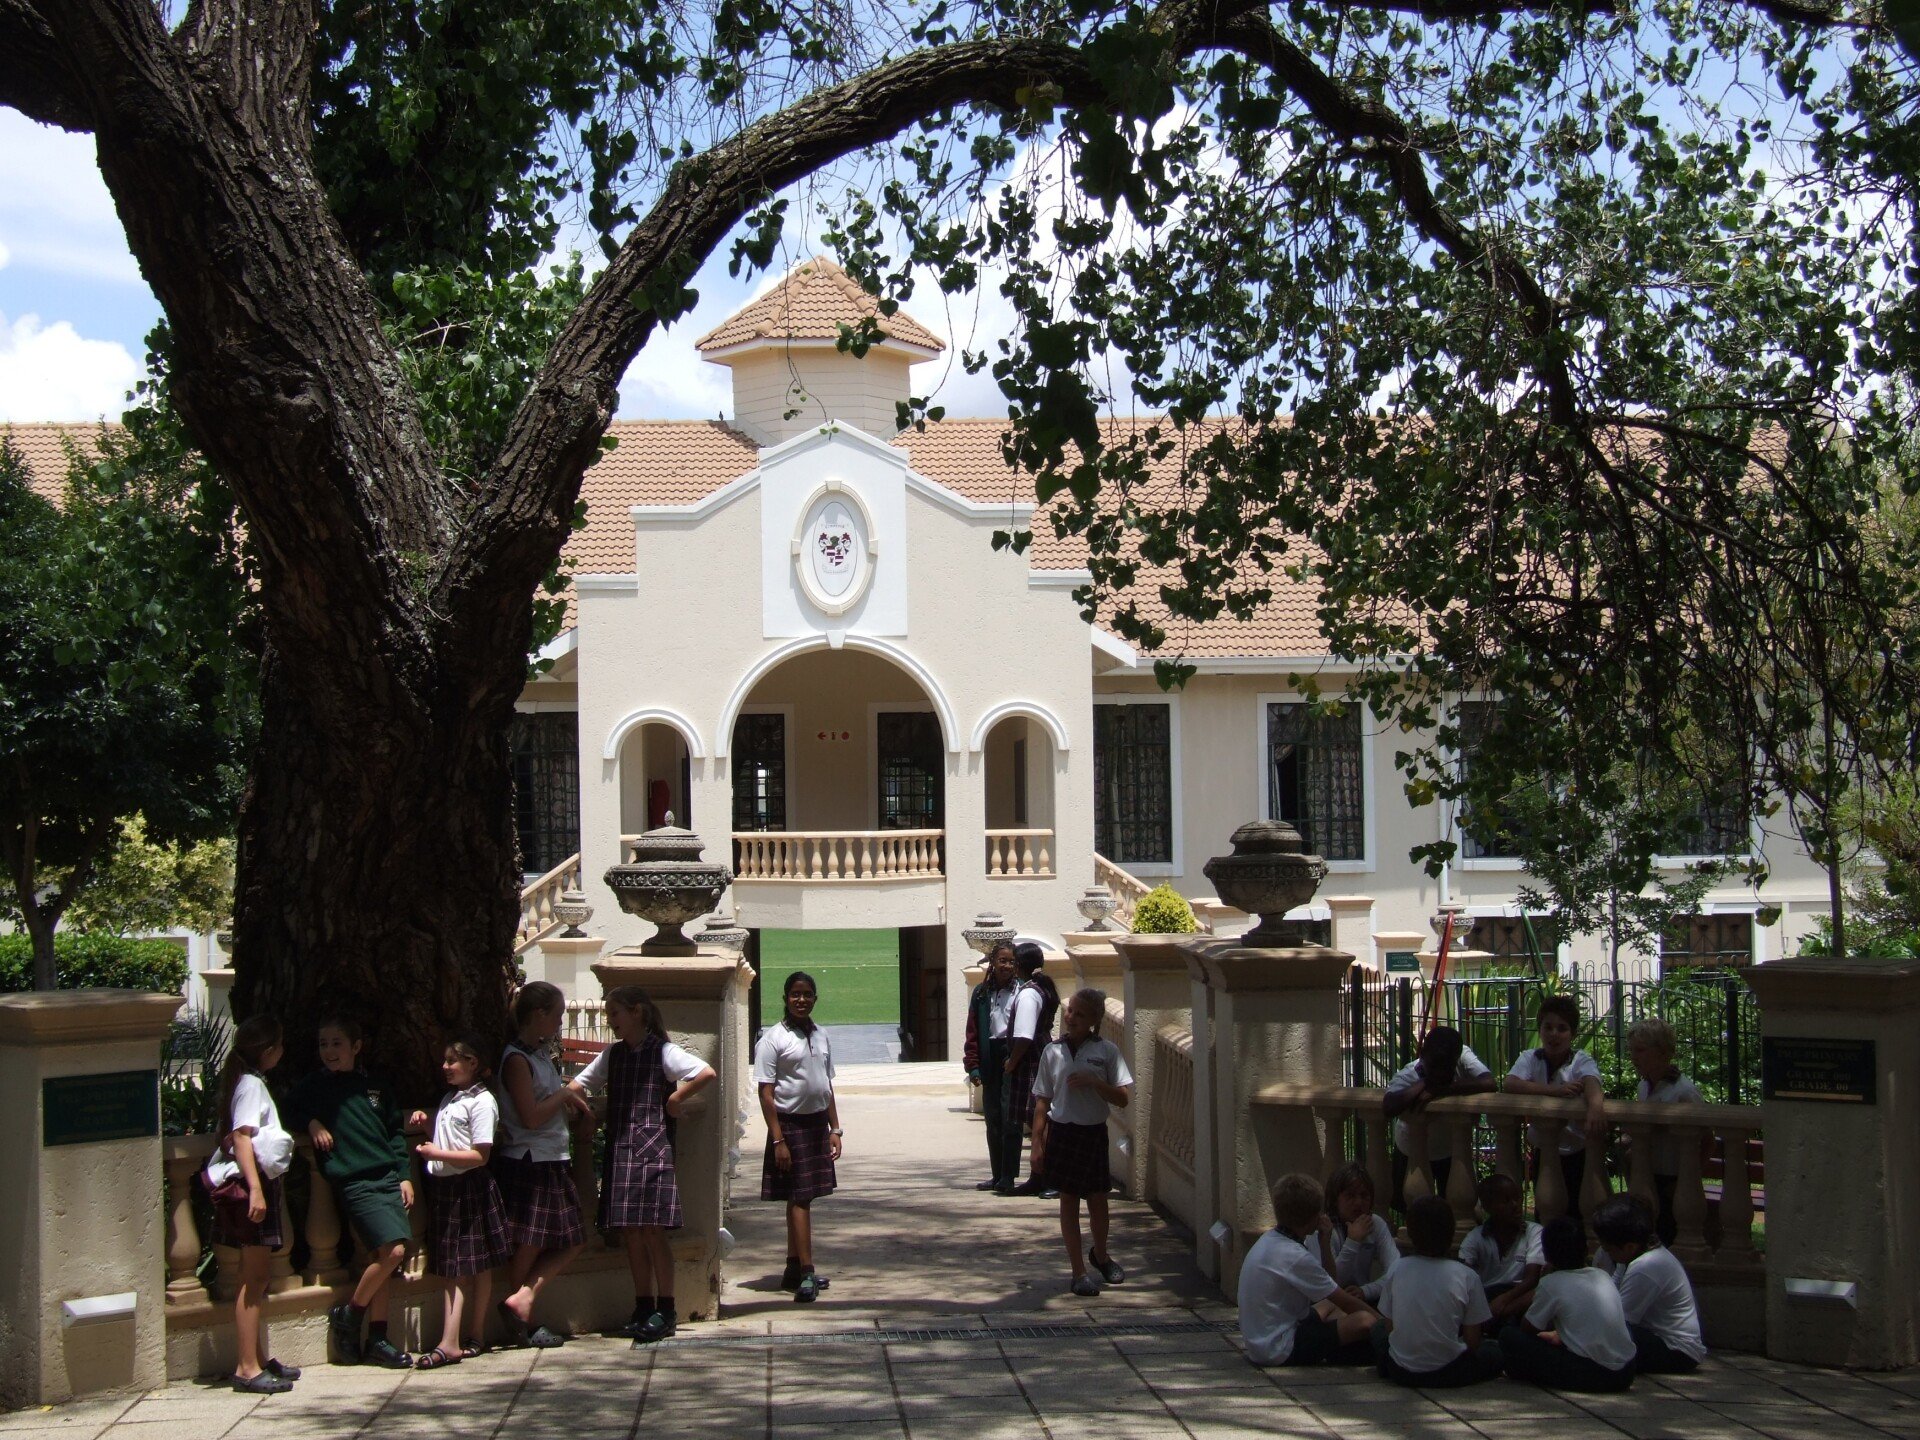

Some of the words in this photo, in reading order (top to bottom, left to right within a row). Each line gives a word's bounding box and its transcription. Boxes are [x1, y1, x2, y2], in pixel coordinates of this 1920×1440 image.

[1786, 1070, 1826, 1080] GRADE
[1789, 1080, 1831, 1091] GRADE
[1836, 1082, 1849, 1091] 00
